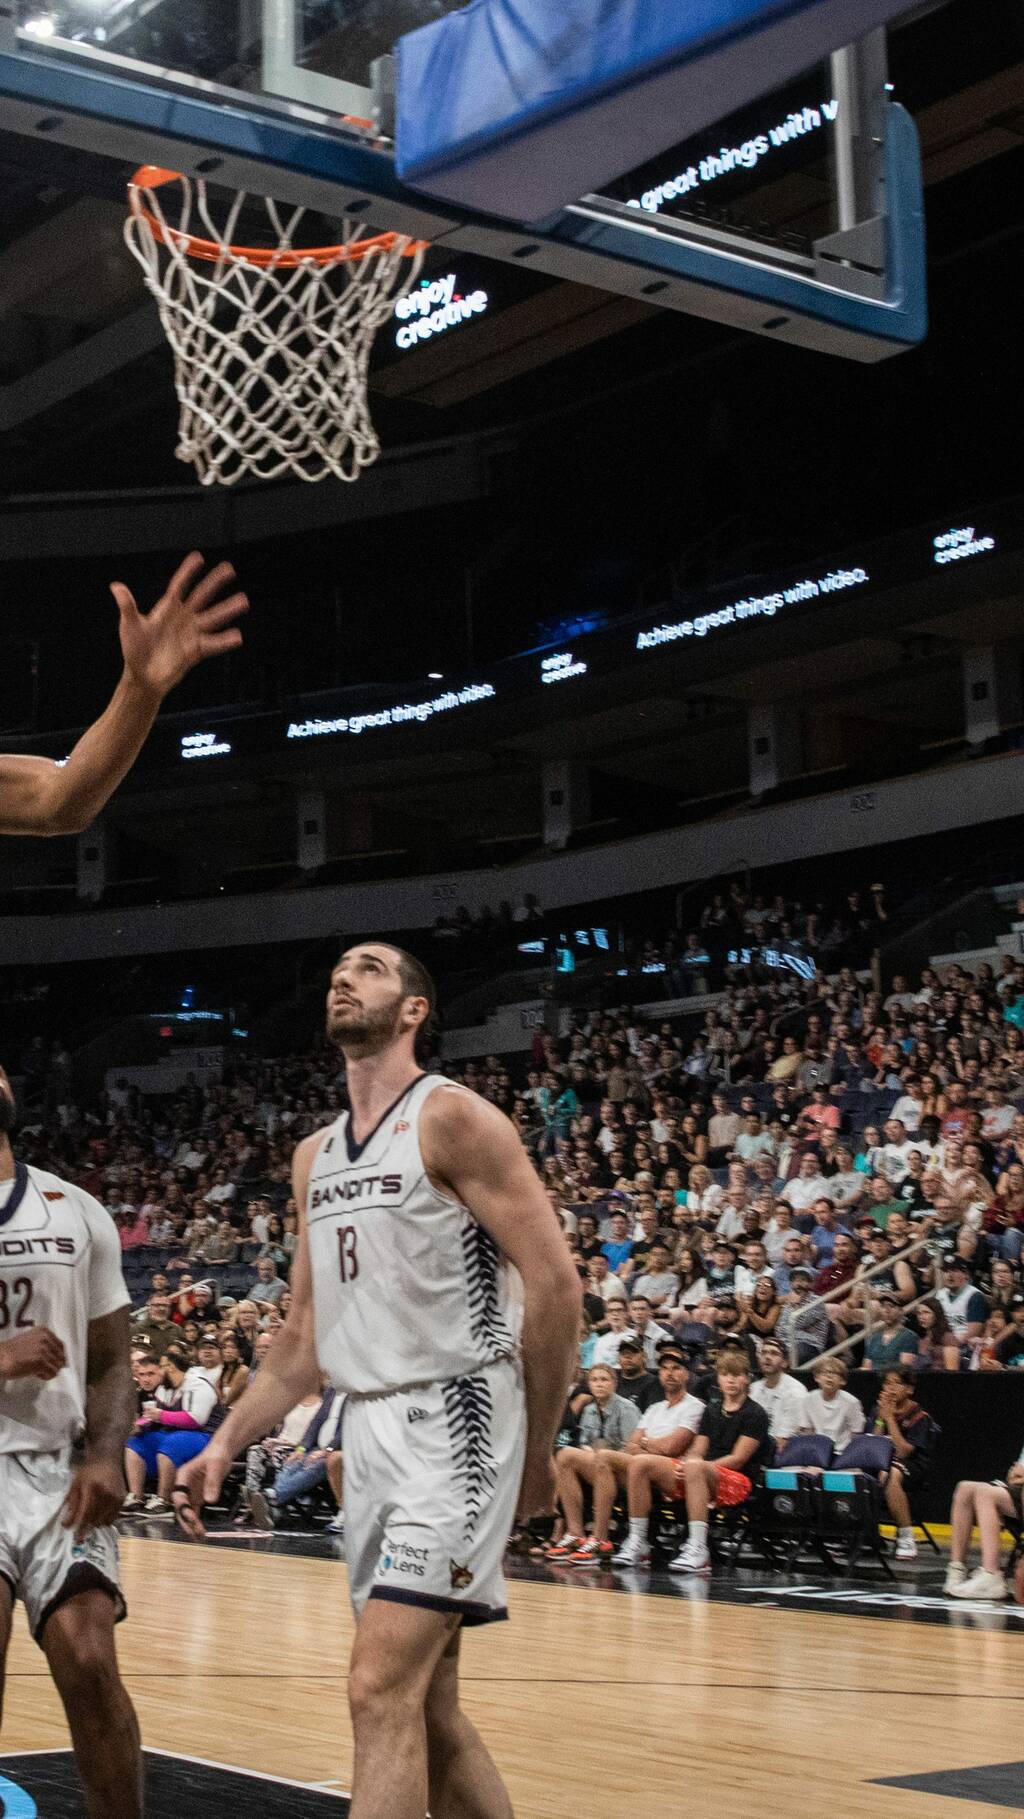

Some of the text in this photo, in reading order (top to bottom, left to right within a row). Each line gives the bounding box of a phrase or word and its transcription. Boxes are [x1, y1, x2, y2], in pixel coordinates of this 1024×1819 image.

[641, 167, 699, 212] great
[699, 135, 768, 180] things
[769, 107, 821, 146] with
[395, 274, 456, 319] enjoy
[636, 621, 693, 649] Achieve
[693, 605, 736, 637] great
[735, 593, 784, 616] things
[783, 580, 819, 604] with
[287, 716, 349, 738] Achieve
[348, 709, 392, 733] great
[391, 702, 434, 722] things
[433, 690, 460, 712] with
[311, 1174, 403, 1210] BANDITS
[337, 1226, 359, 1284] 13
[393, 1557, 425, 1577] Lens
